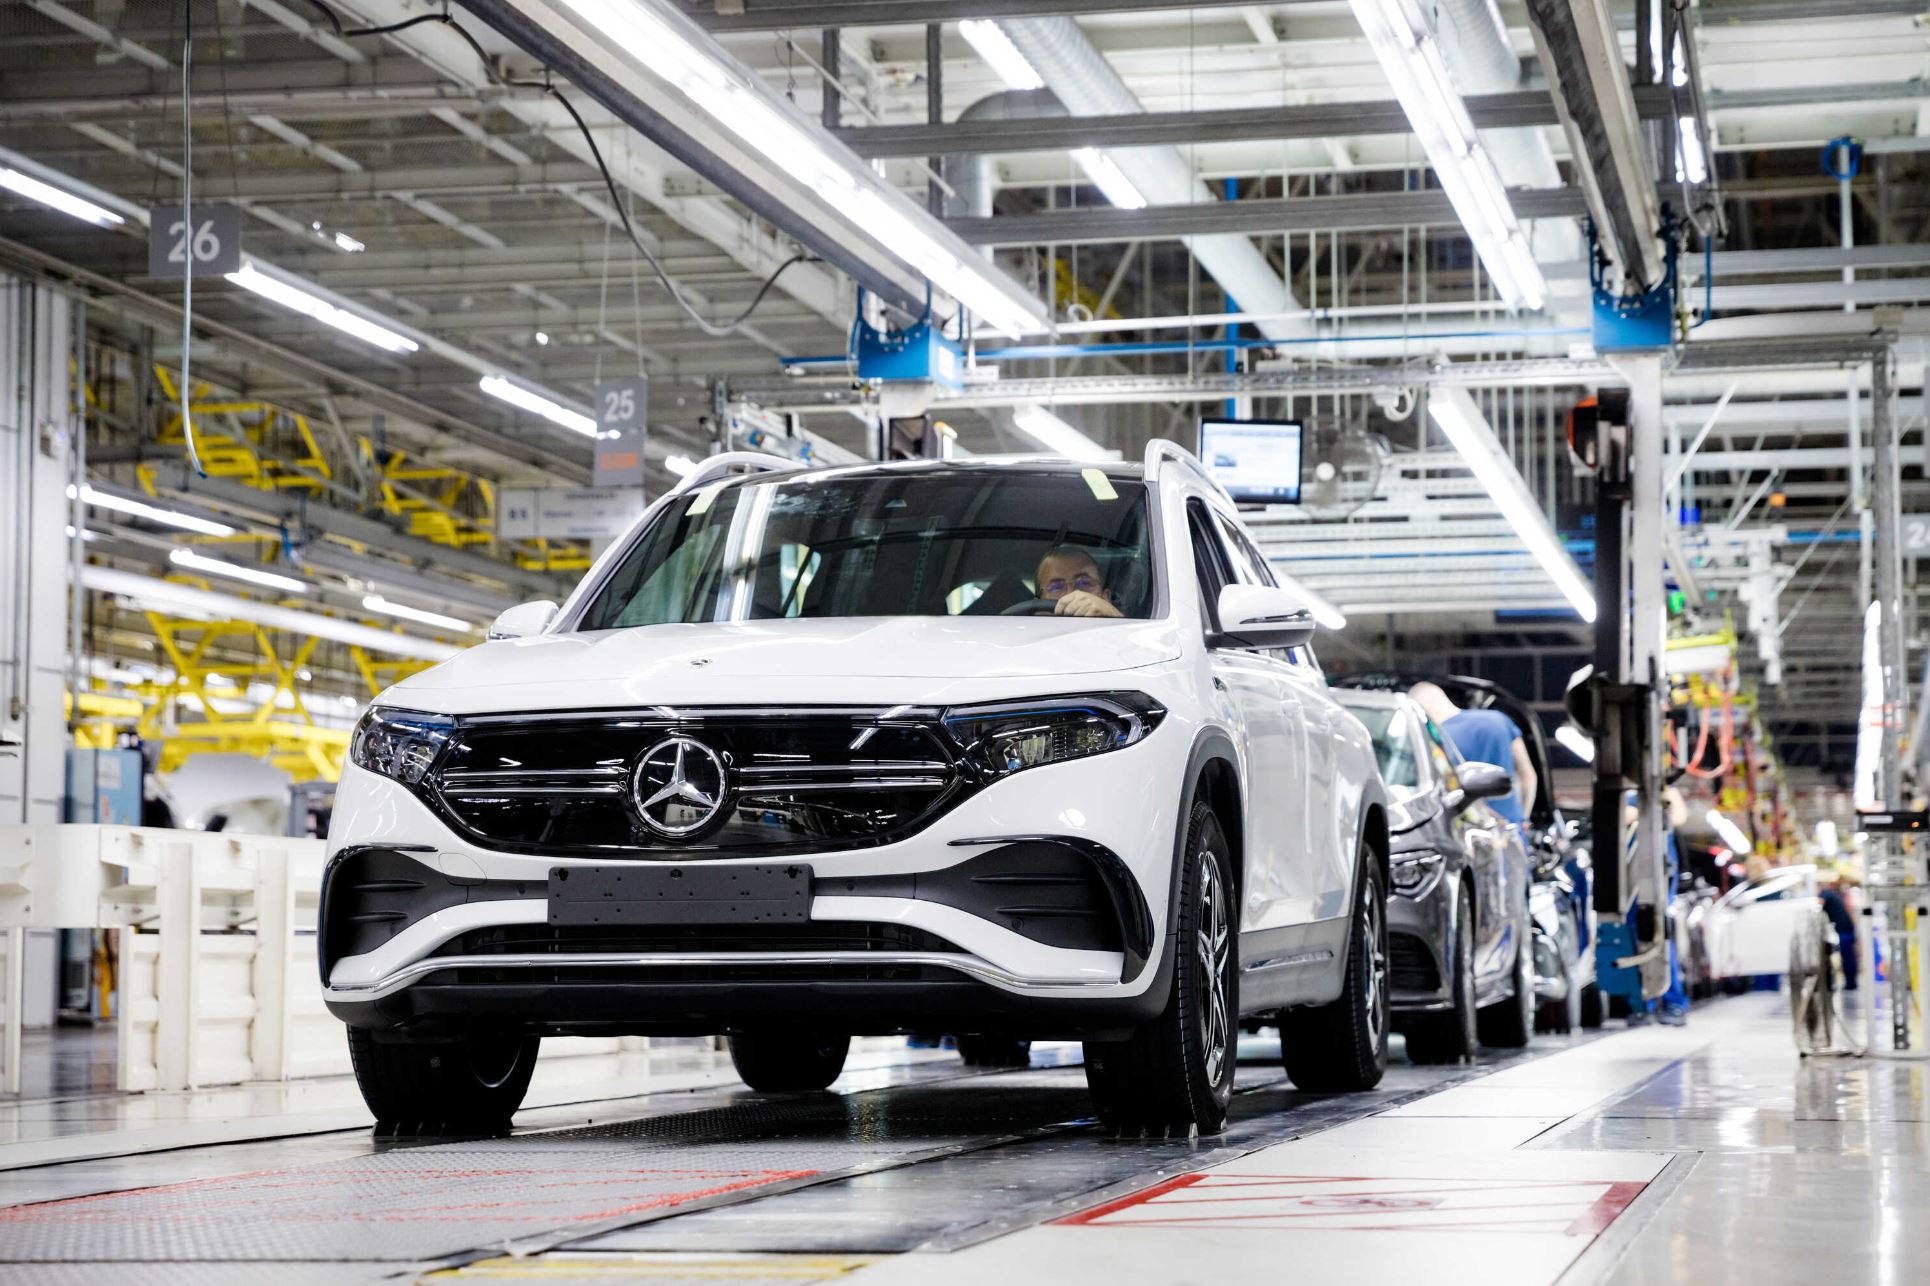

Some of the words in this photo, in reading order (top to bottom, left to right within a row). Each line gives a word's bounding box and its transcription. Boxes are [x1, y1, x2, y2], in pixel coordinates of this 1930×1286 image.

[168, 220, 220, 262] 26
[604, 389, 635, 422] 25
[1907, 521, 1930, 548] 2
